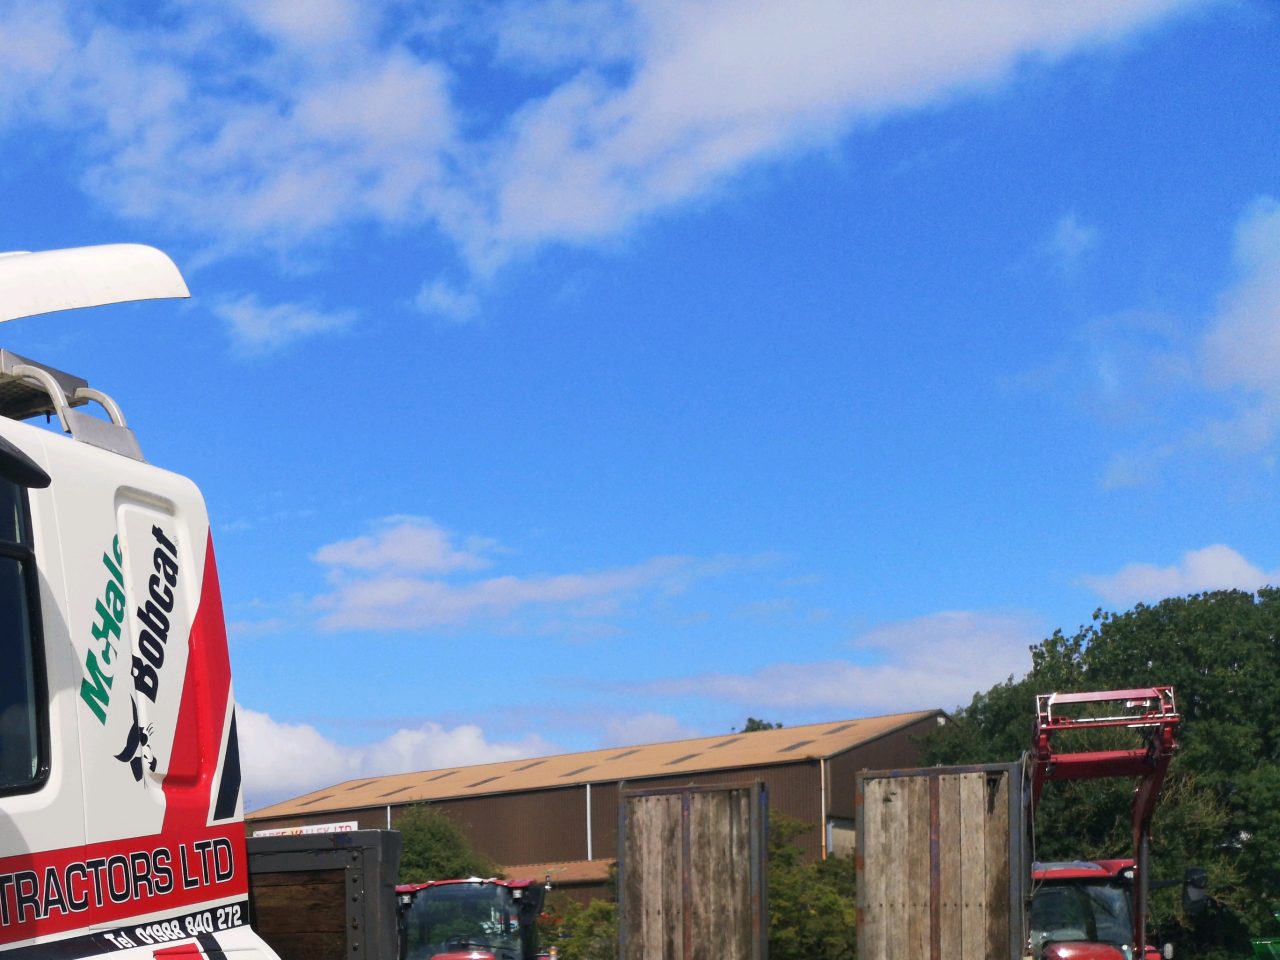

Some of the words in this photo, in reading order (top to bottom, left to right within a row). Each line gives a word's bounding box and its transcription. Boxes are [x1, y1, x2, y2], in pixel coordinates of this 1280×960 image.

[131, 524, 180, 703] Bobcat
[180, 836, 236, 890] LTD
[104, 931, 137, 949] Tel
[135, 919, 186, 944] 01988
[185, 911, 214, 936] 840
[216, 904, 243, 930] 272
